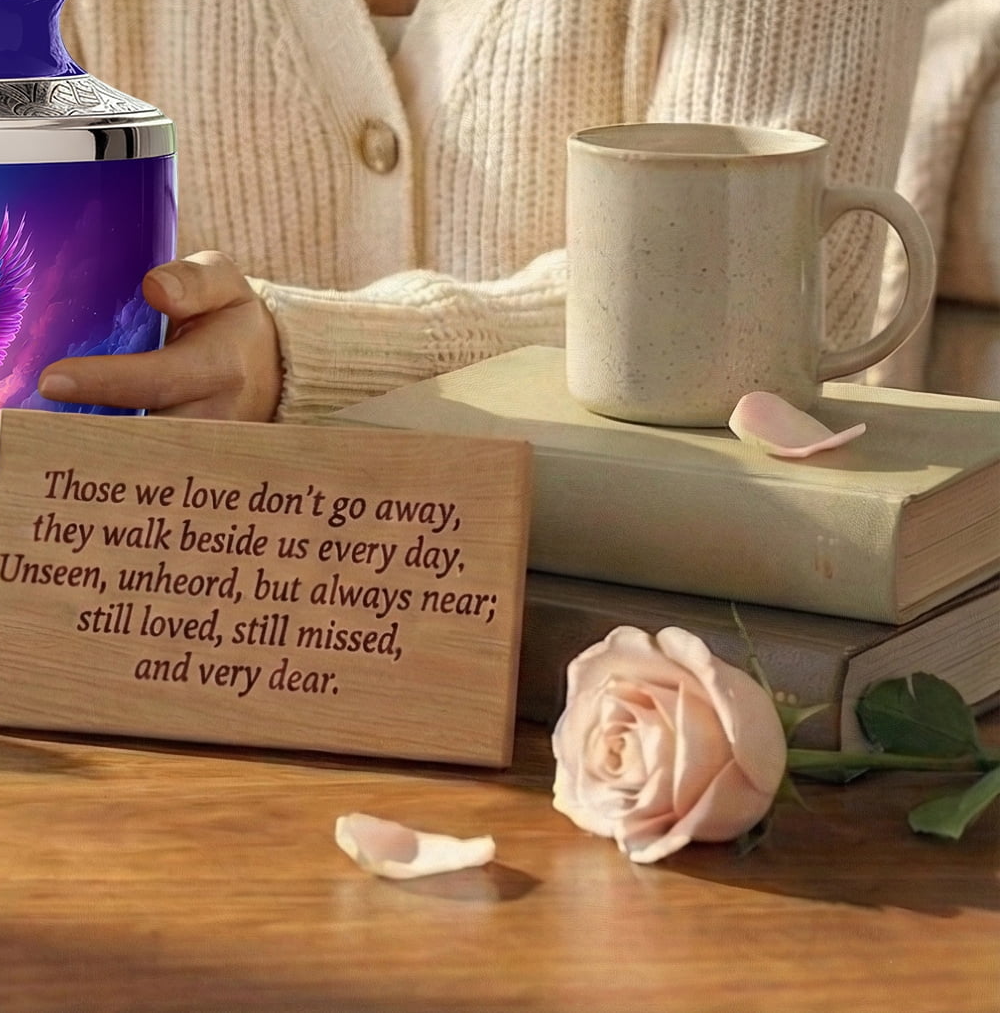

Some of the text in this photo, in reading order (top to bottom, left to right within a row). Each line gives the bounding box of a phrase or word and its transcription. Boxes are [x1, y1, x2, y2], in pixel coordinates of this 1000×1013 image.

[44, 468, 462, 534] Those we love don’t go away,
[32, 512, 95, 554] they
[102, 516, 173, 551] walk
[179, 518, 269, 557] beside
[277, 537, 310, 560] us
[318, 539, 398, 575] every
[0, 553, 107, 595] Unseen,
[254, 567, 302, 603] but
[310, 573, 413, 619] always
[420, 590, 497, 624] near;
[76, 602, 402, 662] still loved, still missed,
[134, 651, 339, 698] and very dear.
